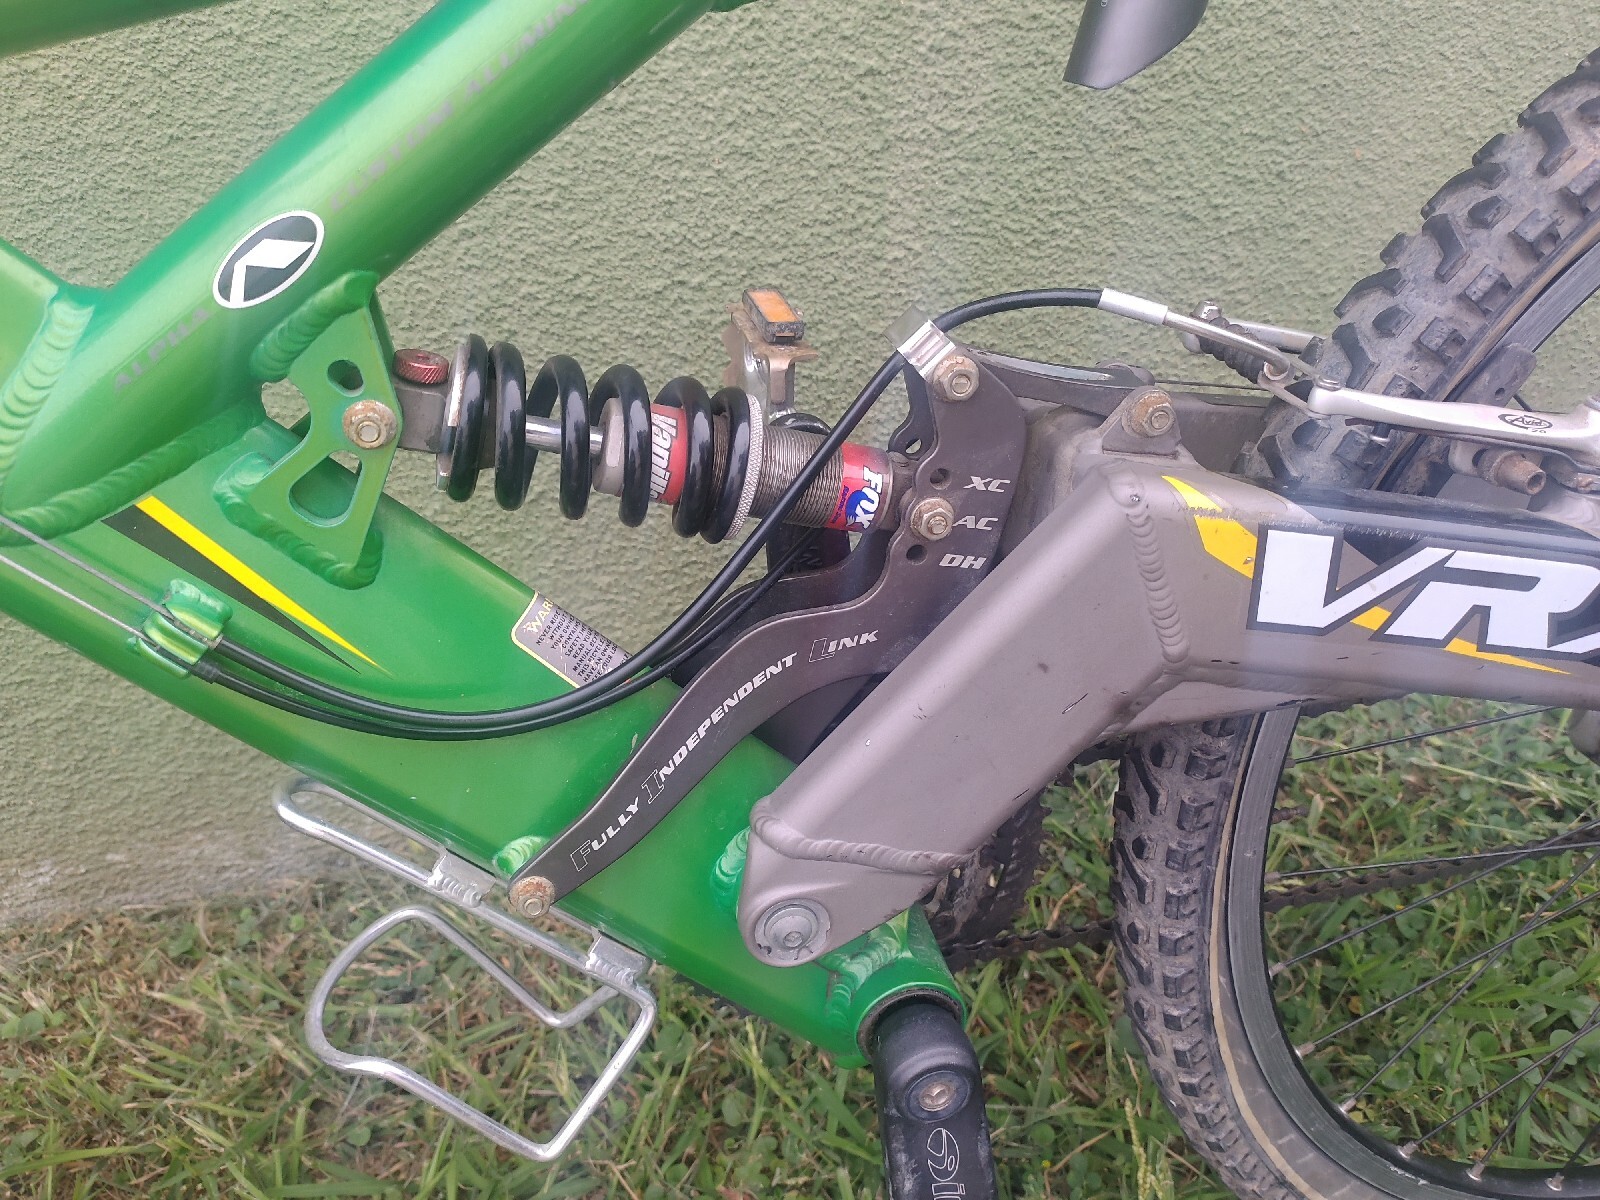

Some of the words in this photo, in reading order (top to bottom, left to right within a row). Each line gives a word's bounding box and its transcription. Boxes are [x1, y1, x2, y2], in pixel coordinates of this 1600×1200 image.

[962, 475, 1011, 493] XC
[852, 465, 883, 529] FOX
[951, 515, 999, 531] AC
[938, 553, 987, 570] DH
[536, 625, 552, 646] NEVER
[549, 613, 568, 641] WITHOUT
[551, 631, 564, 650] YOUR
[564, 634, 580, 657] SAFETY
[572, 642, 585, 659] READ
[572, 647, 591, 672] MANUAL
[577, 663, 590, 678] THIS
[569, 796, 640, 872] FULLY
[640, 651, 798, 804] INDEPENDENT
[808, 629, 879, 662] LINK
